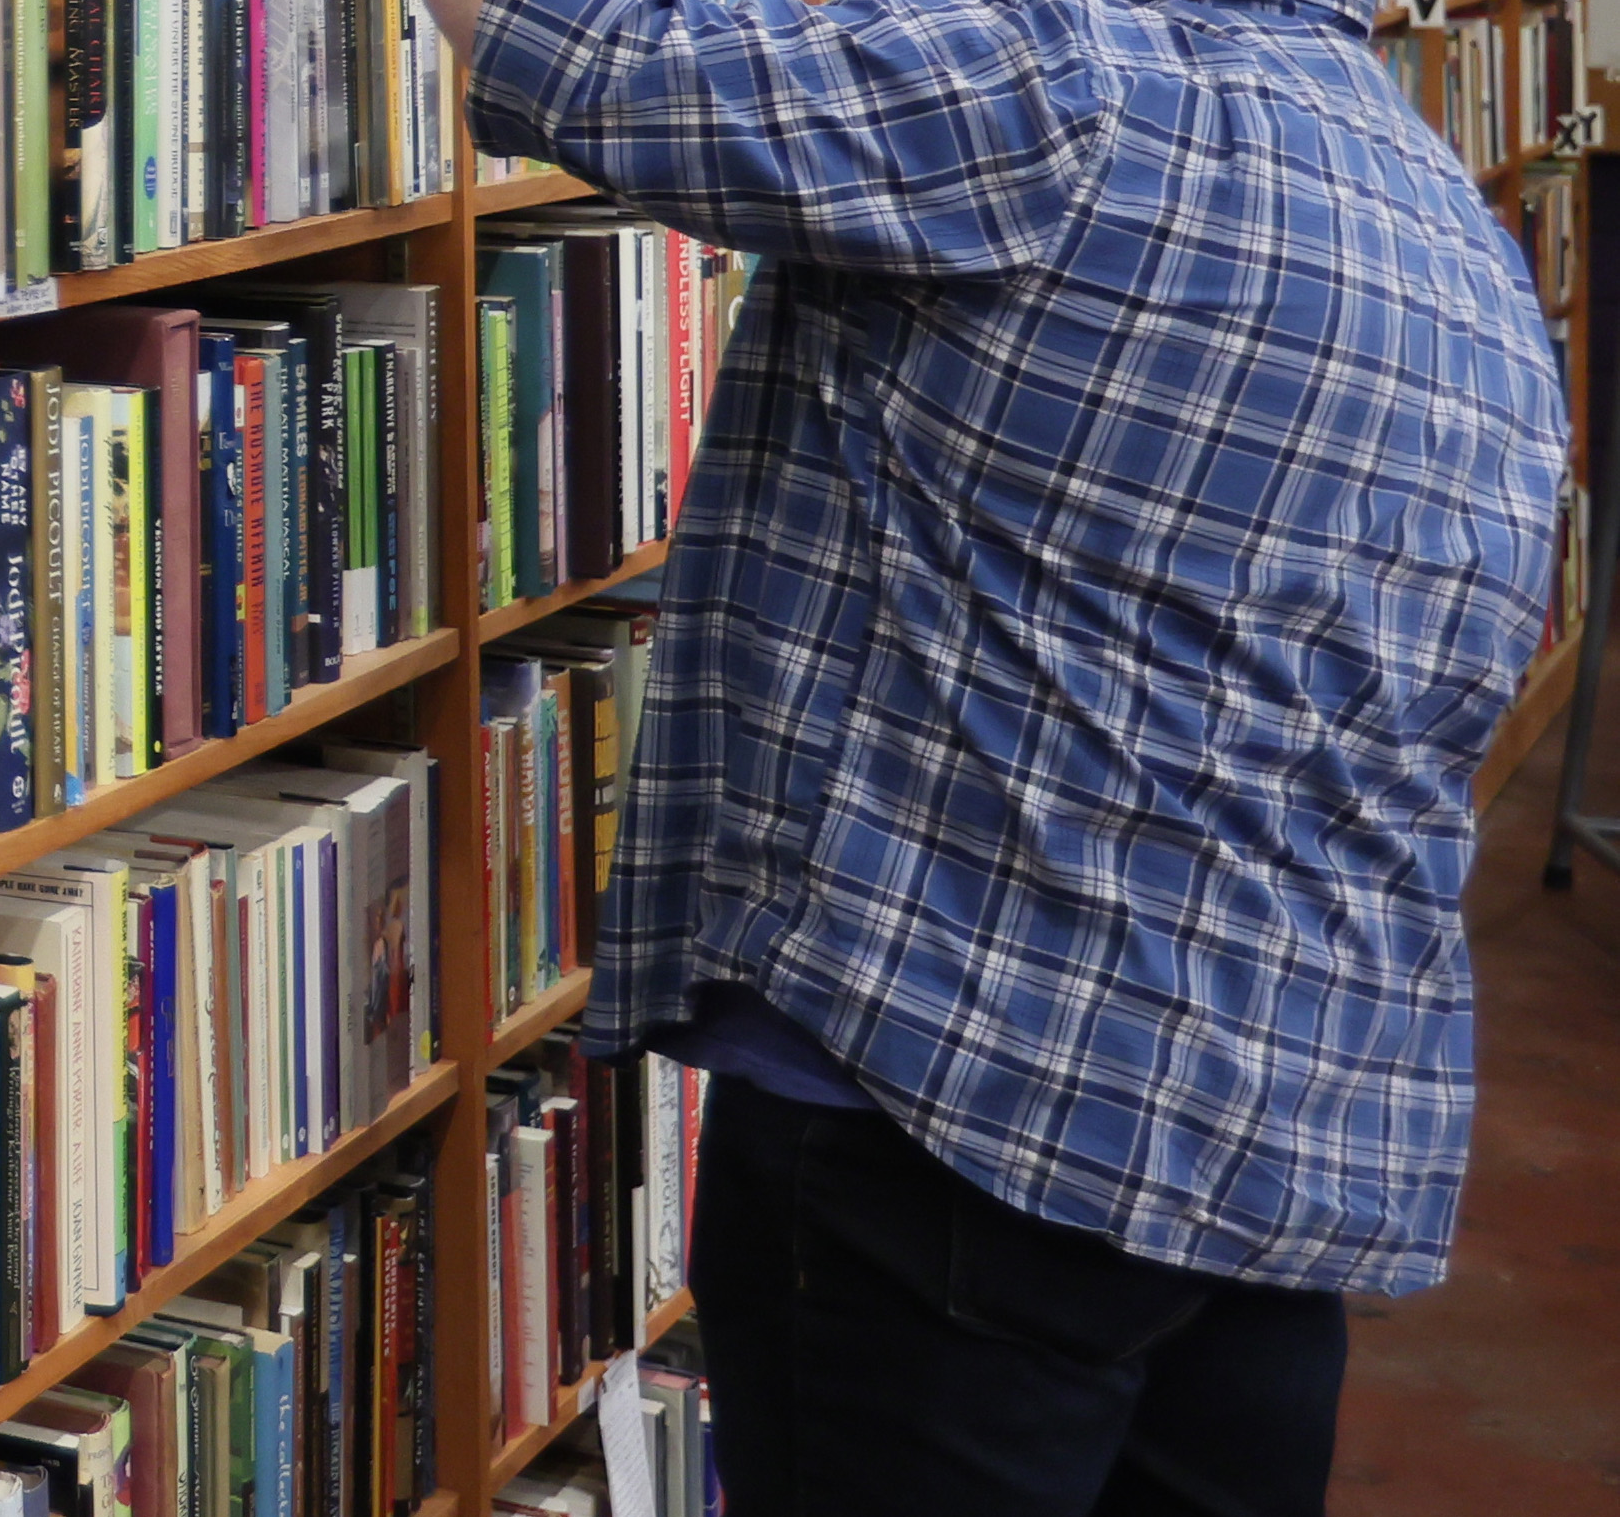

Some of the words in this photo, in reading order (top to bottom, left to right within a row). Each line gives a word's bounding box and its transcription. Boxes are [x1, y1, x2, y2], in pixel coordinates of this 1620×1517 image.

[67, 46, 83, 131] MASTER
[87, 38, 103, 119] CHART
[1555, 114, 1579, 153] X
[1577, 106, 1598, 144] Y
[279, 365, 289, 398] THE
[294, 362, 309, 390] 54
[319, 383, 335, 431] PARK
[45, 382, 62, 456] JODI
[280, 404, 289, 441] LATE
[295, 395, 310, 458] MILES
[0, 463, 10, 526] NAME
[79, 432, 91, 495] JODI
[46, 470, 64, 605] PICOULT
[81, 502, 93, 613] PICOULT
[281, 516, 291, 581] PASCAL
[7, 552, 25, 617] Jodi
[8, 626, 27, 755] Picoult
